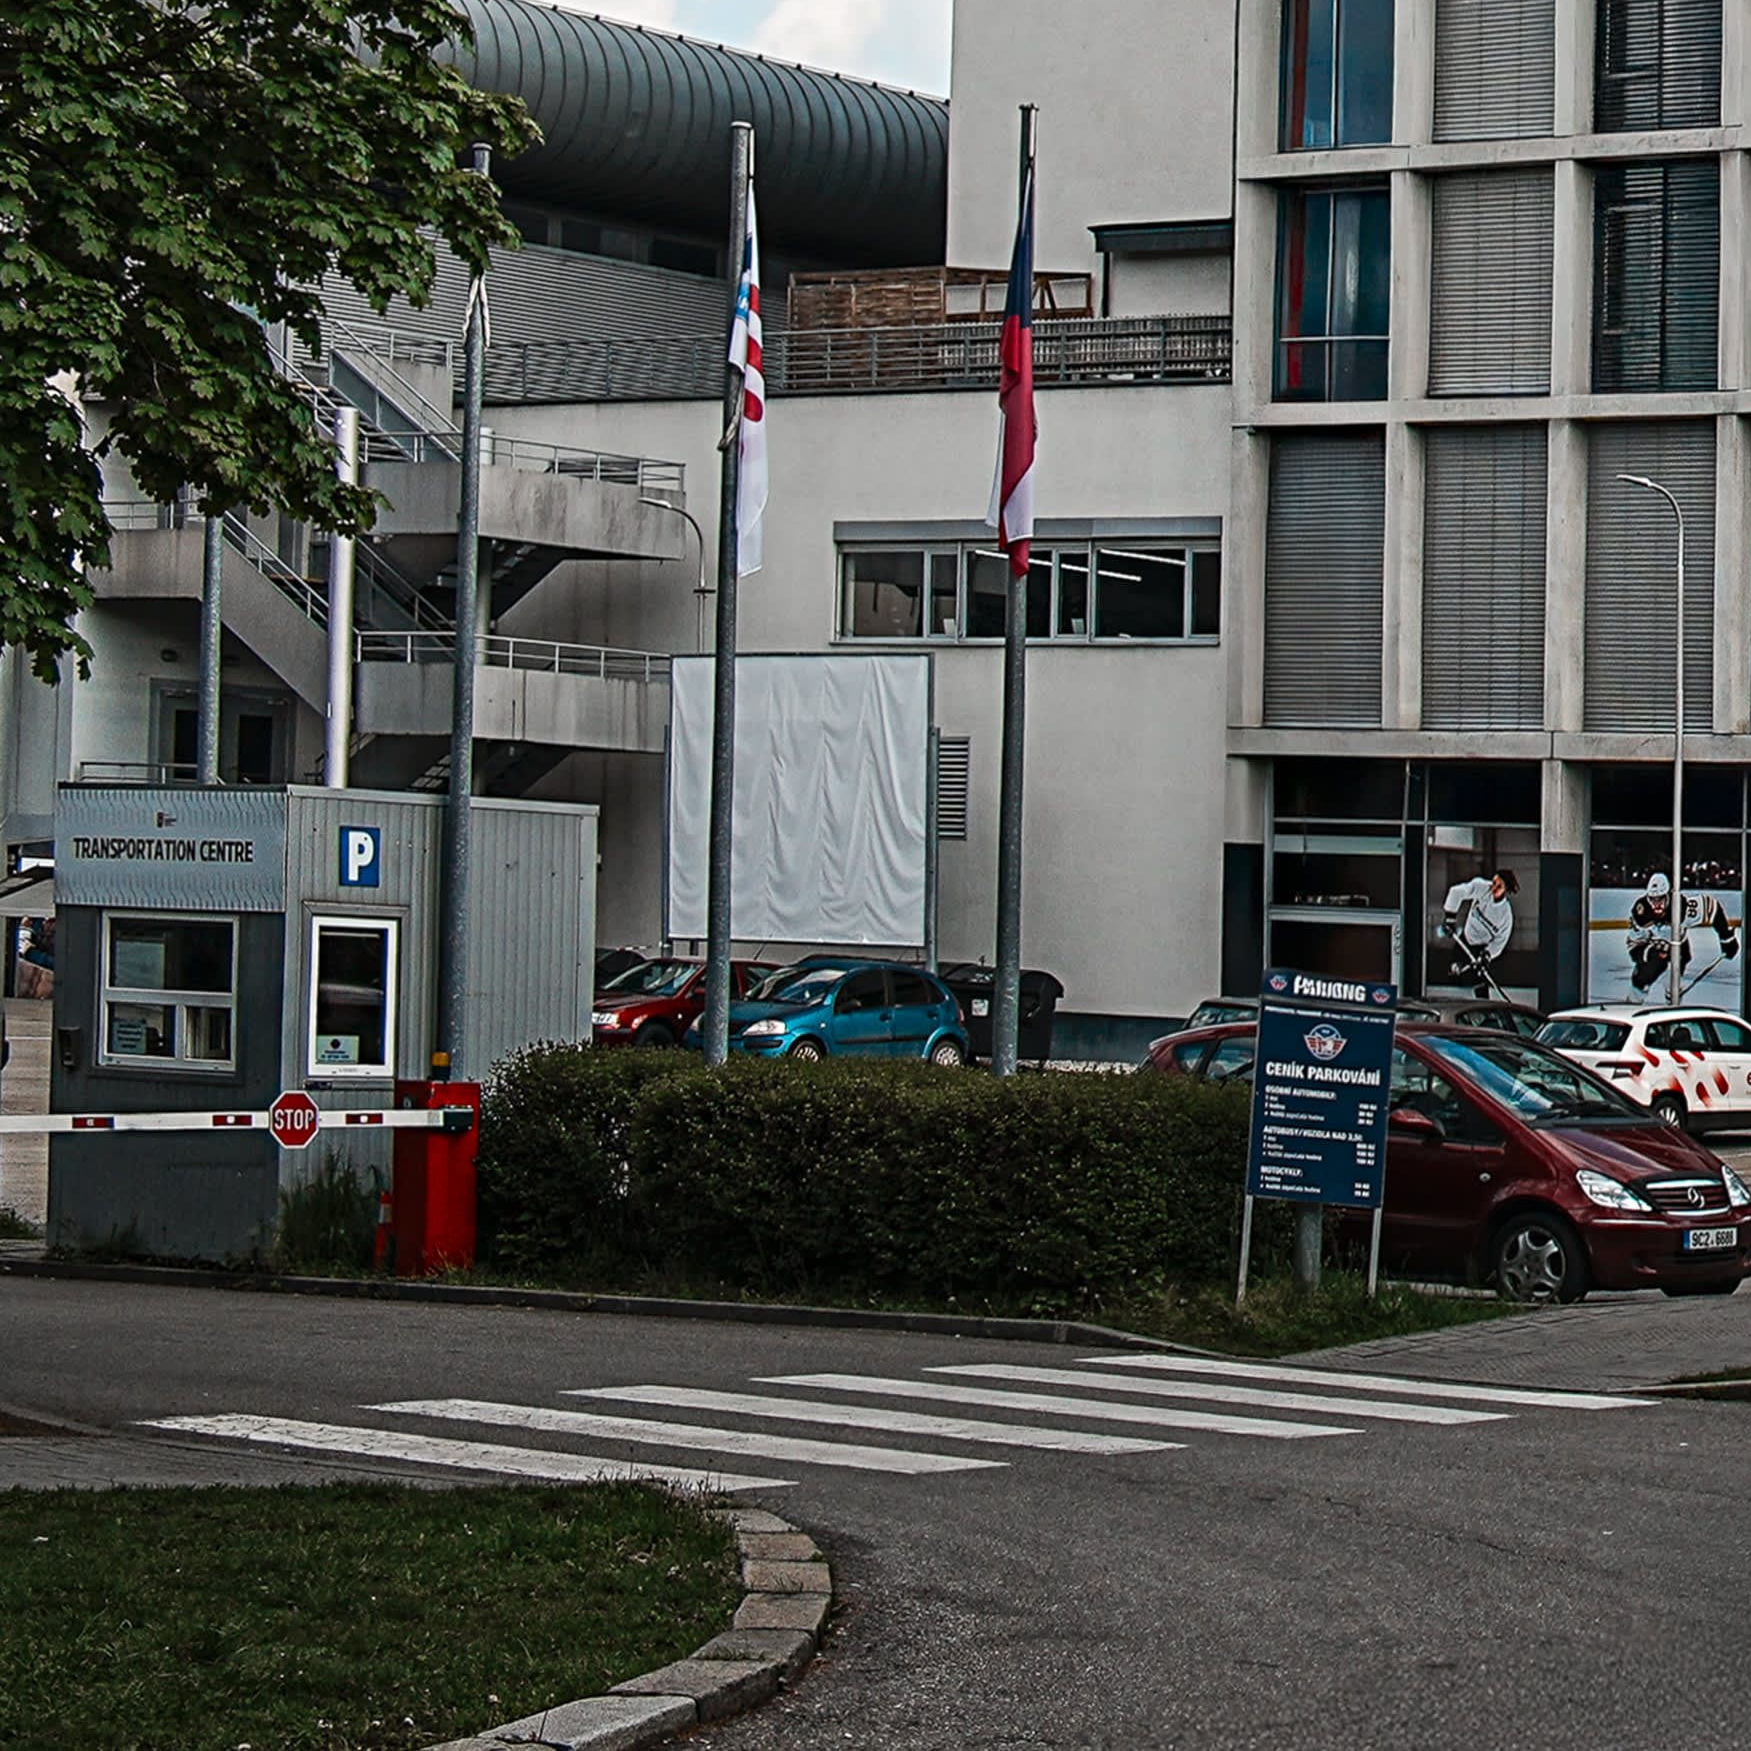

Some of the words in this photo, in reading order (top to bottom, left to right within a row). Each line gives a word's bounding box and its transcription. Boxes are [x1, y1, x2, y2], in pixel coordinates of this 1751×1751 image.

[74, 837, 196, 861] TRANSPORTATION
[200, 839, 253, 862] CENTRE
[348, 832, 374, 881] P
[1265, 1060, 1304, 1080] CENÍK
[1307, 1066, 1381, 1087] PARKOVÁNÍ
[274, 1108, 315, 1130] STOP
